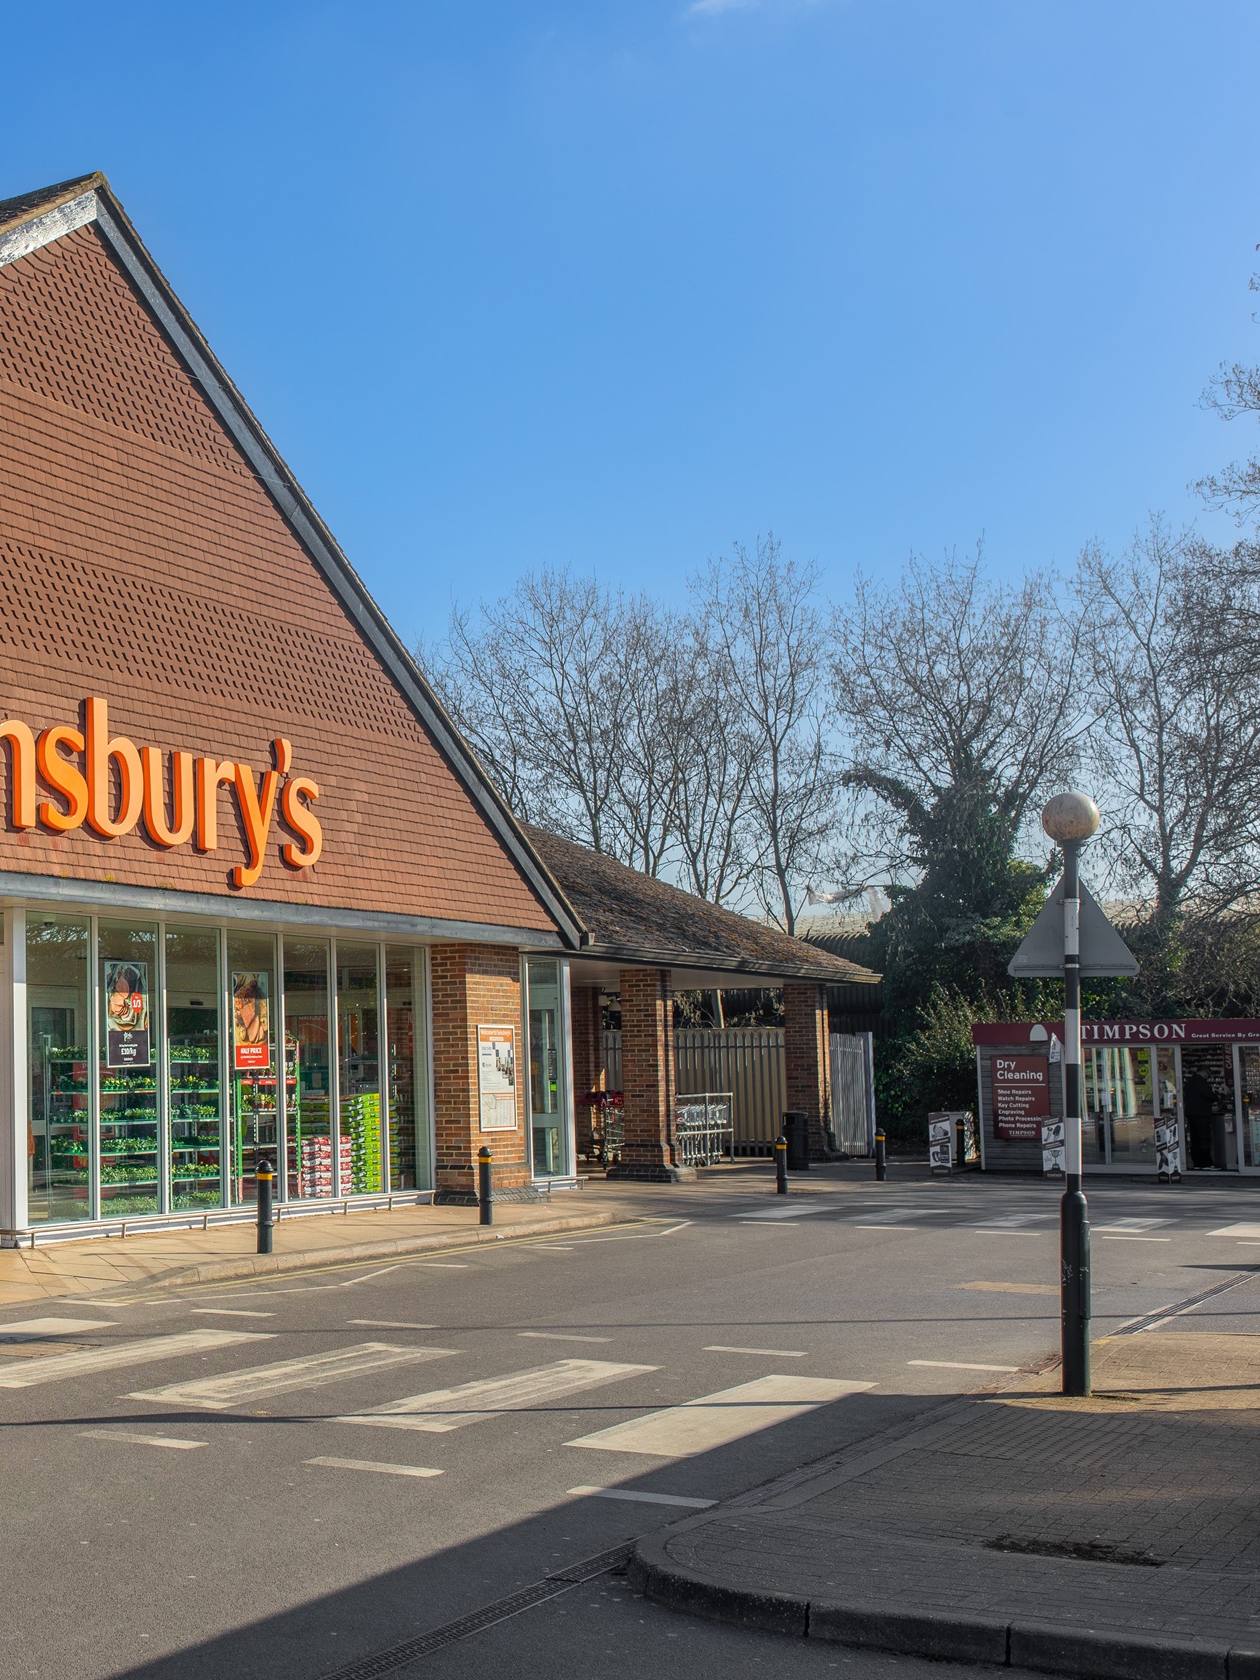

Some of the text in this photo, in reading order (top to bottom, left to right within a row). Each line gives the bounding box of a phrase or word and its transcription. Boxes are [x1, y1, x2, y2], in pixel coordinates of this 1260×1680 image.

[1081, 1024, 1186, 1039] TIMPSON
[997, 1060, 1016, 1070] Dry
[997, 1071, 1043, 1081] Cleaning
